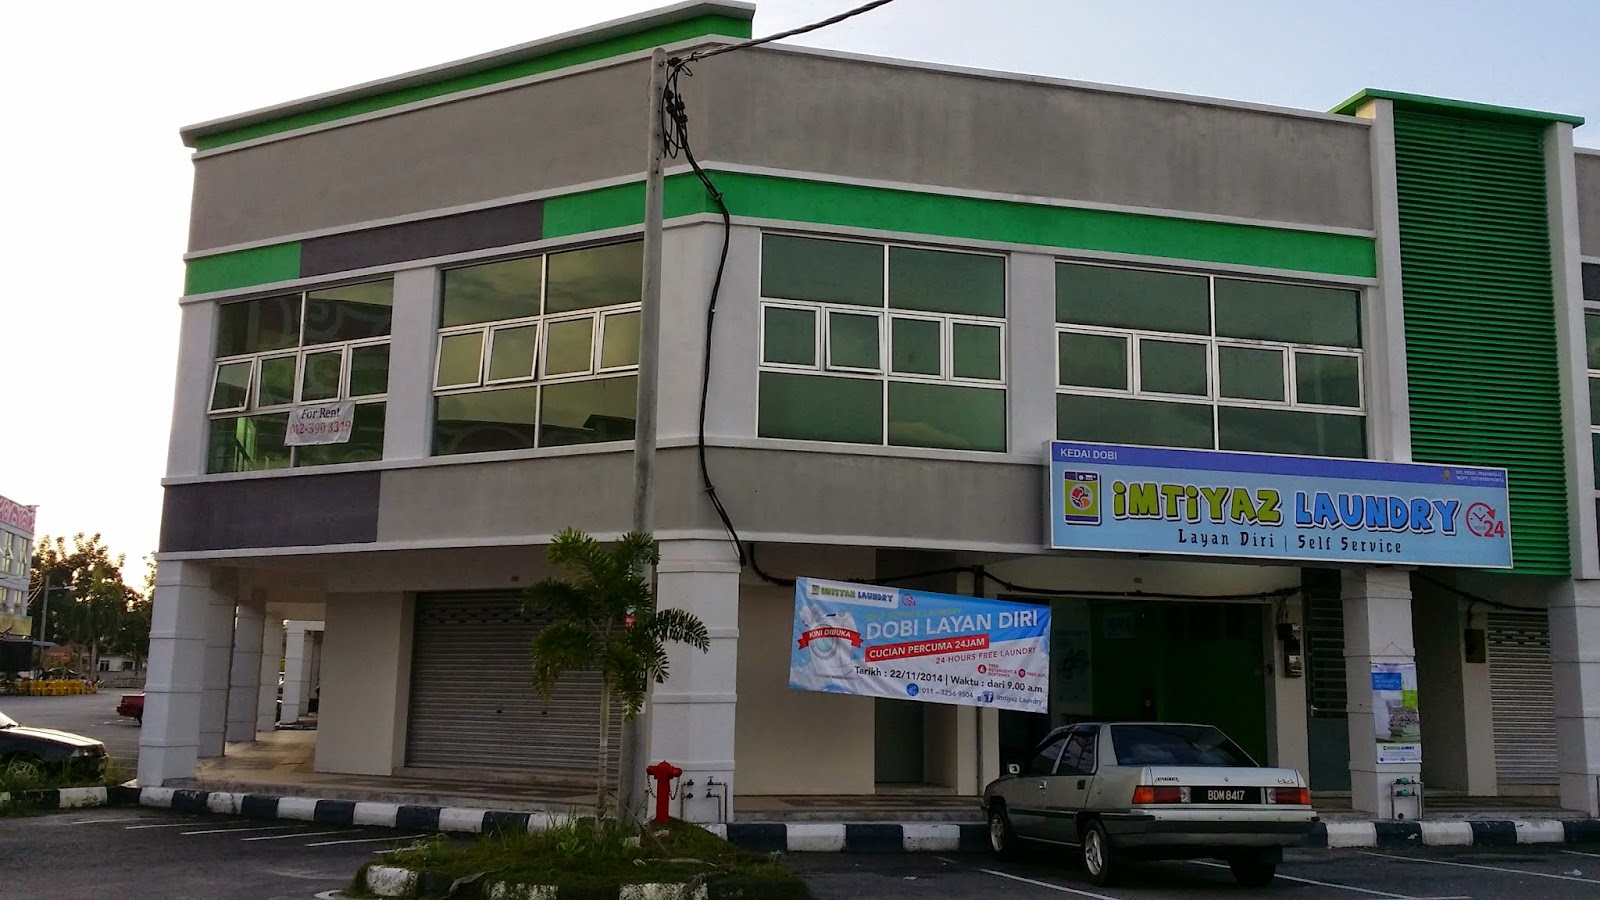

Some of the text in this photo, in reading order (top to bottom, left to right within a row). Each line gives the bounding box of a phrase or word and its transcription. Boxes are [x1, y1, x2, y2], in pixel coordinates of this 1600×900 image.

[301, 407, 341, 419] For Rent
[1060, 448, 1118, 461] KEDAI DOBI
[1295, 491, 1461, 535] LAUNDRY
[1484, 520, 1505, 538] 24
[1178, 529, 1229, 547] Layan
[1240, 532, 1274, 548] Diri
[1298, 535, 1332, 550] Self
[1341, 536, 1401, 553] Service
[857, 591, 894, 602] LAUNDRY
[866, 610, 1038, 640] DOBI LAYAN DIRI
[809, 629, 851, 638] KINI DIBUKA
[869, 638, 985, 659] CUCIAN PERCUMA 24JAM
[935, 646, 1037, 665] 24 HOURS FREE LAUNDRY
[855, 665, 882, 677] Tarikh
[890, 669, 942, 683] 22/11/2014
[949, 676, 979, 687] Waktu
[987, 679, 1005, 689] dari
[1007, 681, 1026, 691] 9.00
[1027, 684, 1043, 693] a.m
[1019, 696, 1043, 706] Laundry
[1207, 789, 1246, 801] BDM 8417
